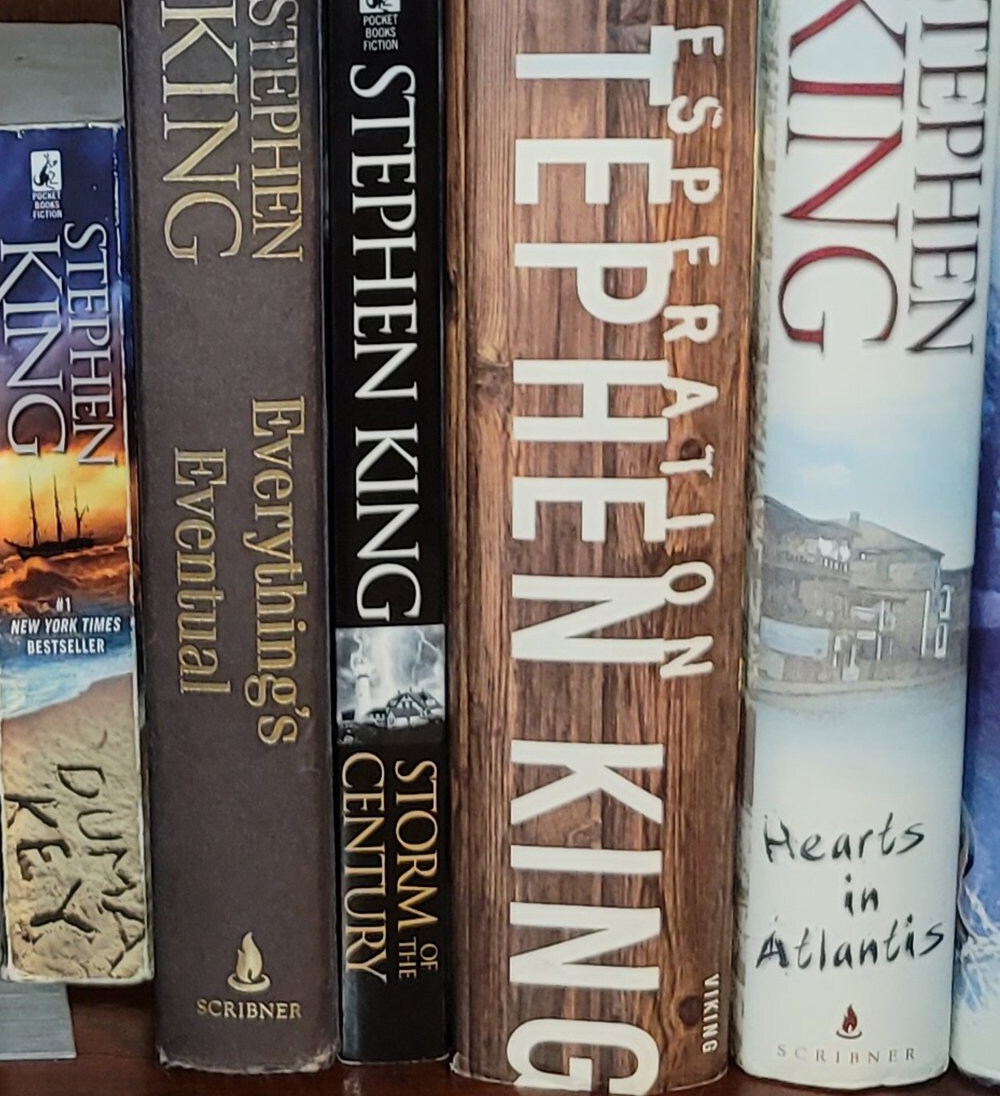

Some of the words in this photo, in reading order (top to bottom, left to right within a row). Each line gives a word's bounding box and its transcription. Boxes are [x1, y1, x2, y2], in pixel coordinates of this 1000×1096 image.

[363, 14, 398, 26] POCKET
[365, 26, 396, 39] BOOKS
[363, 39, 398, 52] FICTION
[32, 190, 61, 201] POCKET
[32, 209, 63, 219] FICTION
[34, 201, 60, 210] BOOKS
[349, 64, 418, 401] STEPHEN
[63, 222, 117, 466] STEPHEN
[355, 422, 422, 623] KING
[174, 447, 232, 695] Eventual
[242, 395, 312, 746] Everything's
[11, 618, 41, 635] NEW
[45, 617, 78, 634] YORK
[82, 616, 122, 633] TIMES
[27, 637, 105, 655] BESTSELLER
[394, 760, 439, 932] STORM
[763, 811, 926, 864] Hearts
[3, 792, 101, 934] KEY
[57, 762, 146, 977] DUMA
[341, 751, 388, 985] CENTURY
[507, 739, 665, 1094] KING
[843, 873, 880, 916] in
[398, 936, 417, 980] THE
[420, 942, 439, 971] OF
[756, 913, 945, 972] Atlantis
[196, 998, 303, 1020] SCRIBNER
[702, 972, 720, 1054] VIKING
[776, 1044, 917, 1065] SCRIBNER
